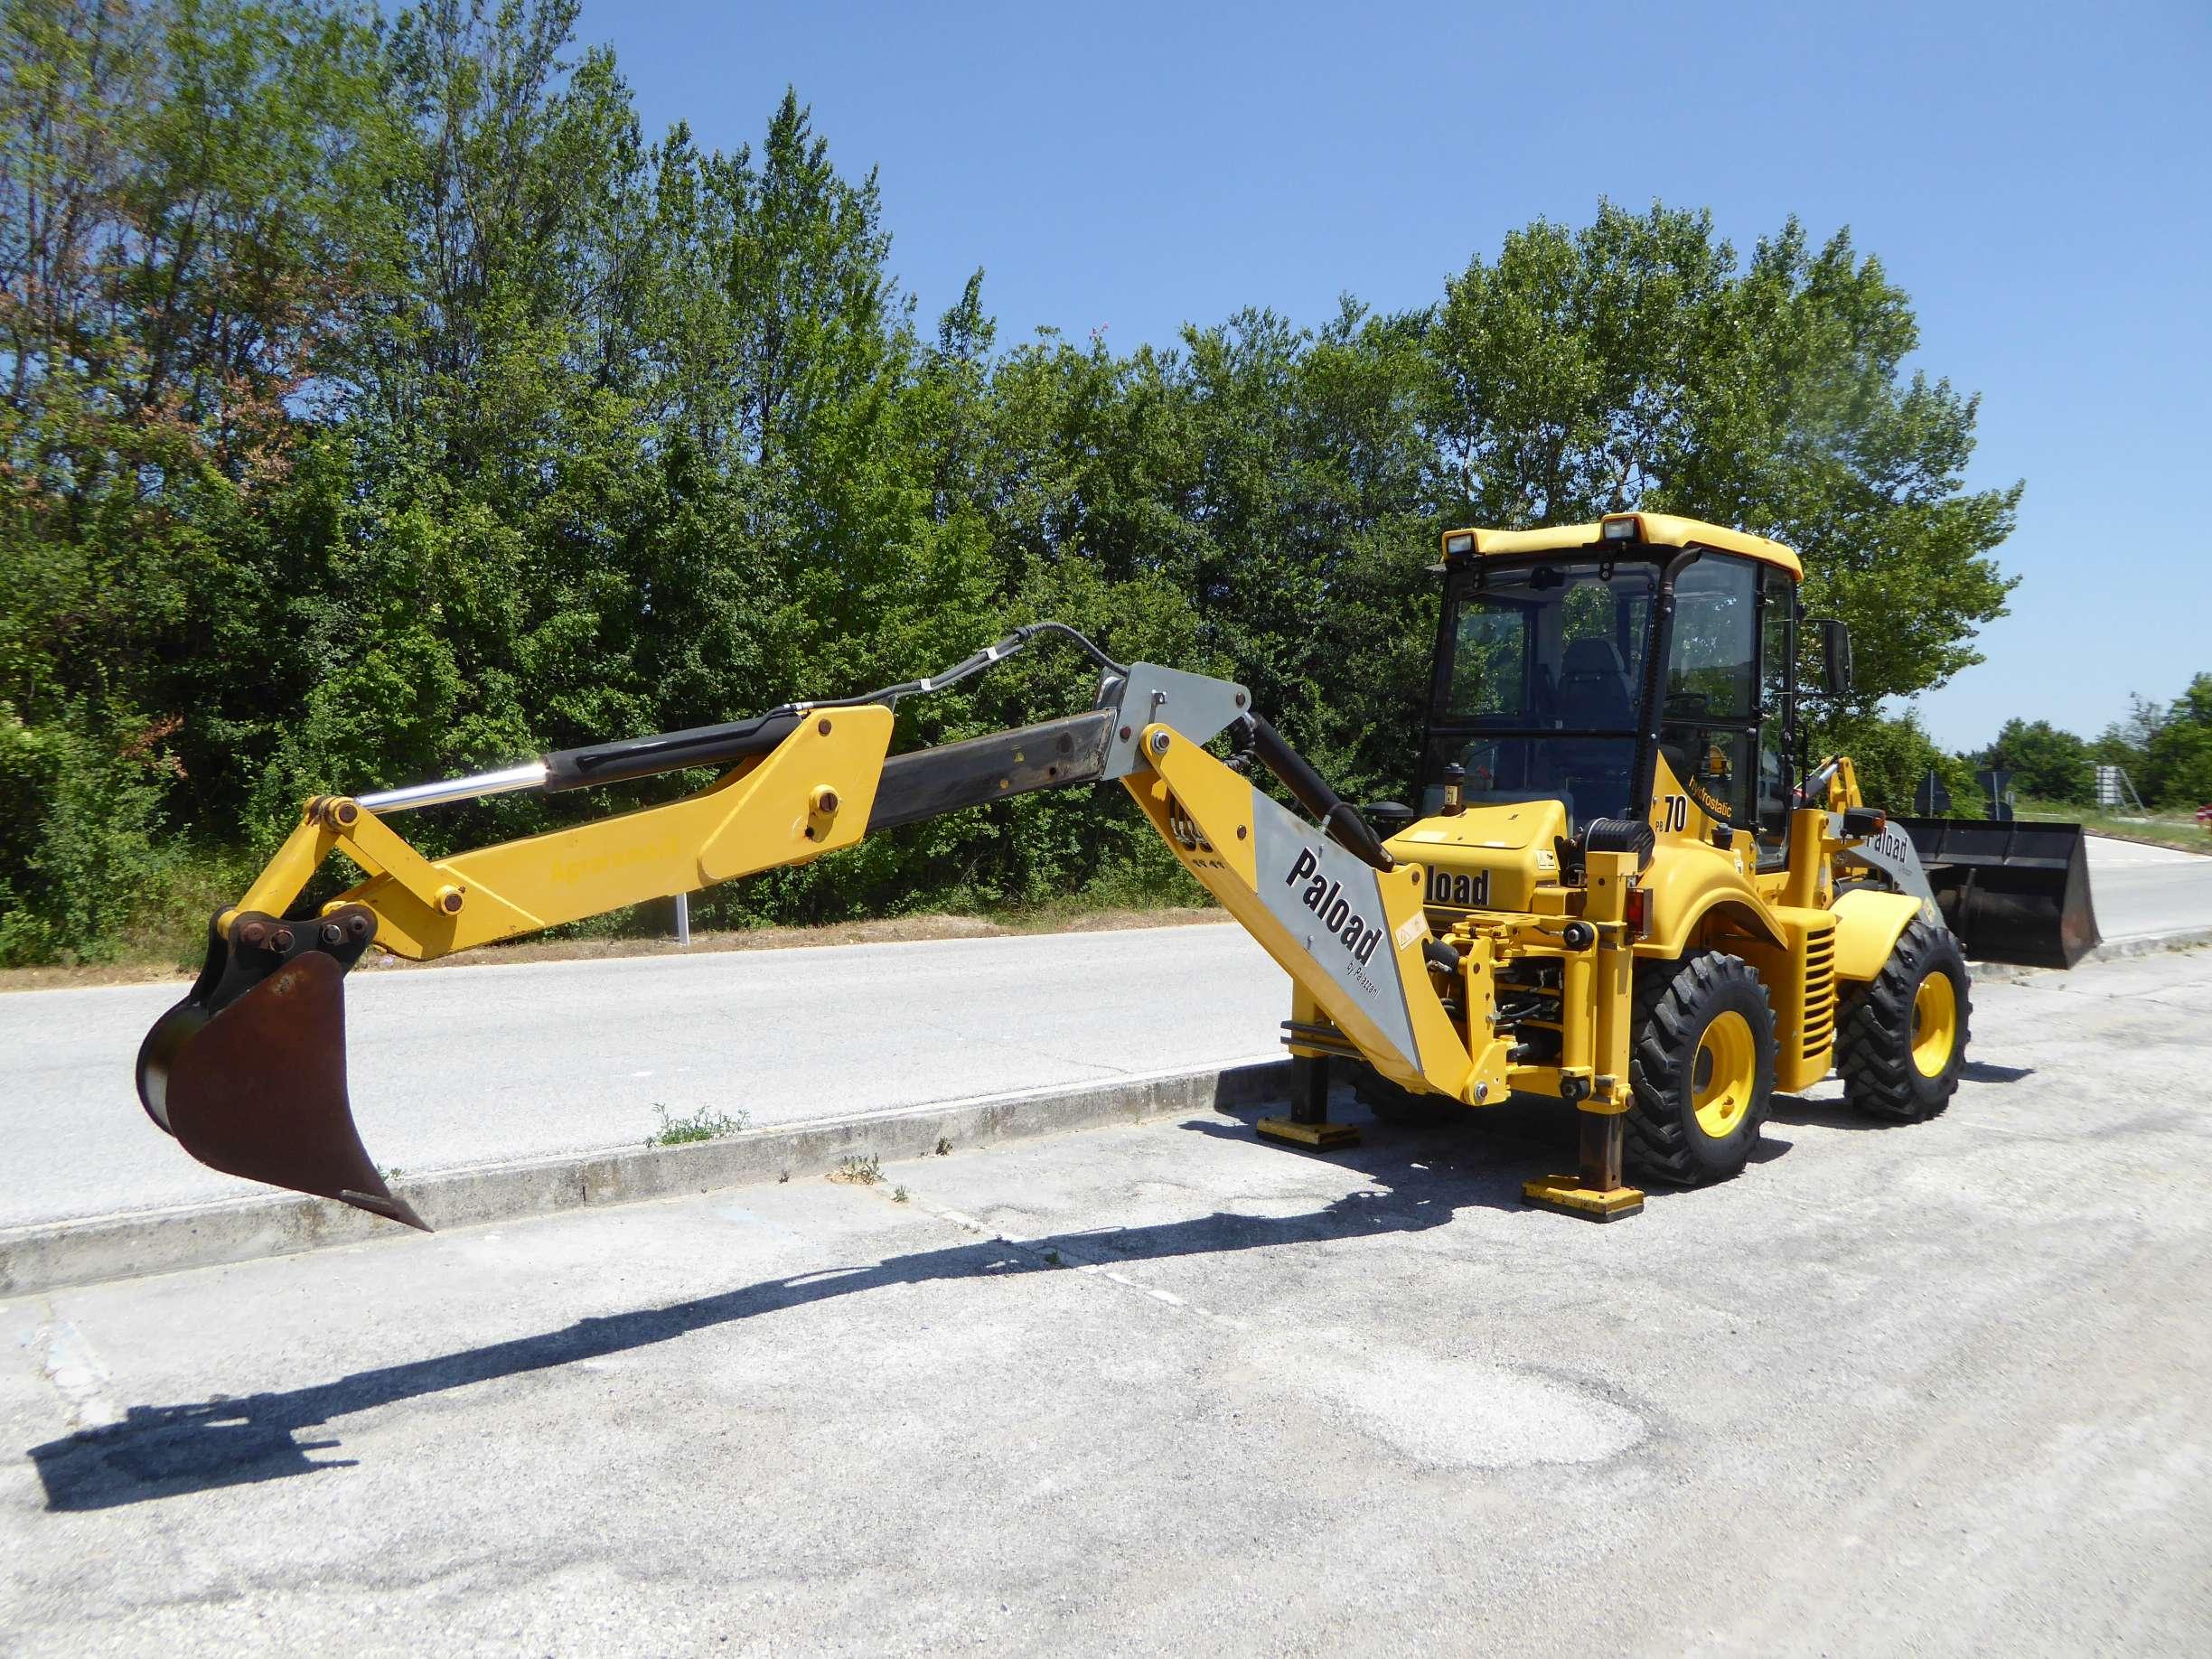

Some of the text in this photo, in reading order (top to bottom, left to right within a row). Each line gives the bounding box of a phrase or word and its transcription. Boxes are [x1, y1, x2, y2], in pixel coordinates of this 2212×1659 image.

[1664, 795, 1688, 832] 70
[1689, 774, 1732, 818] hydrostatic
[1285, 846, 1382, 967] Paload
[1346, 960, 1357, 976] by
